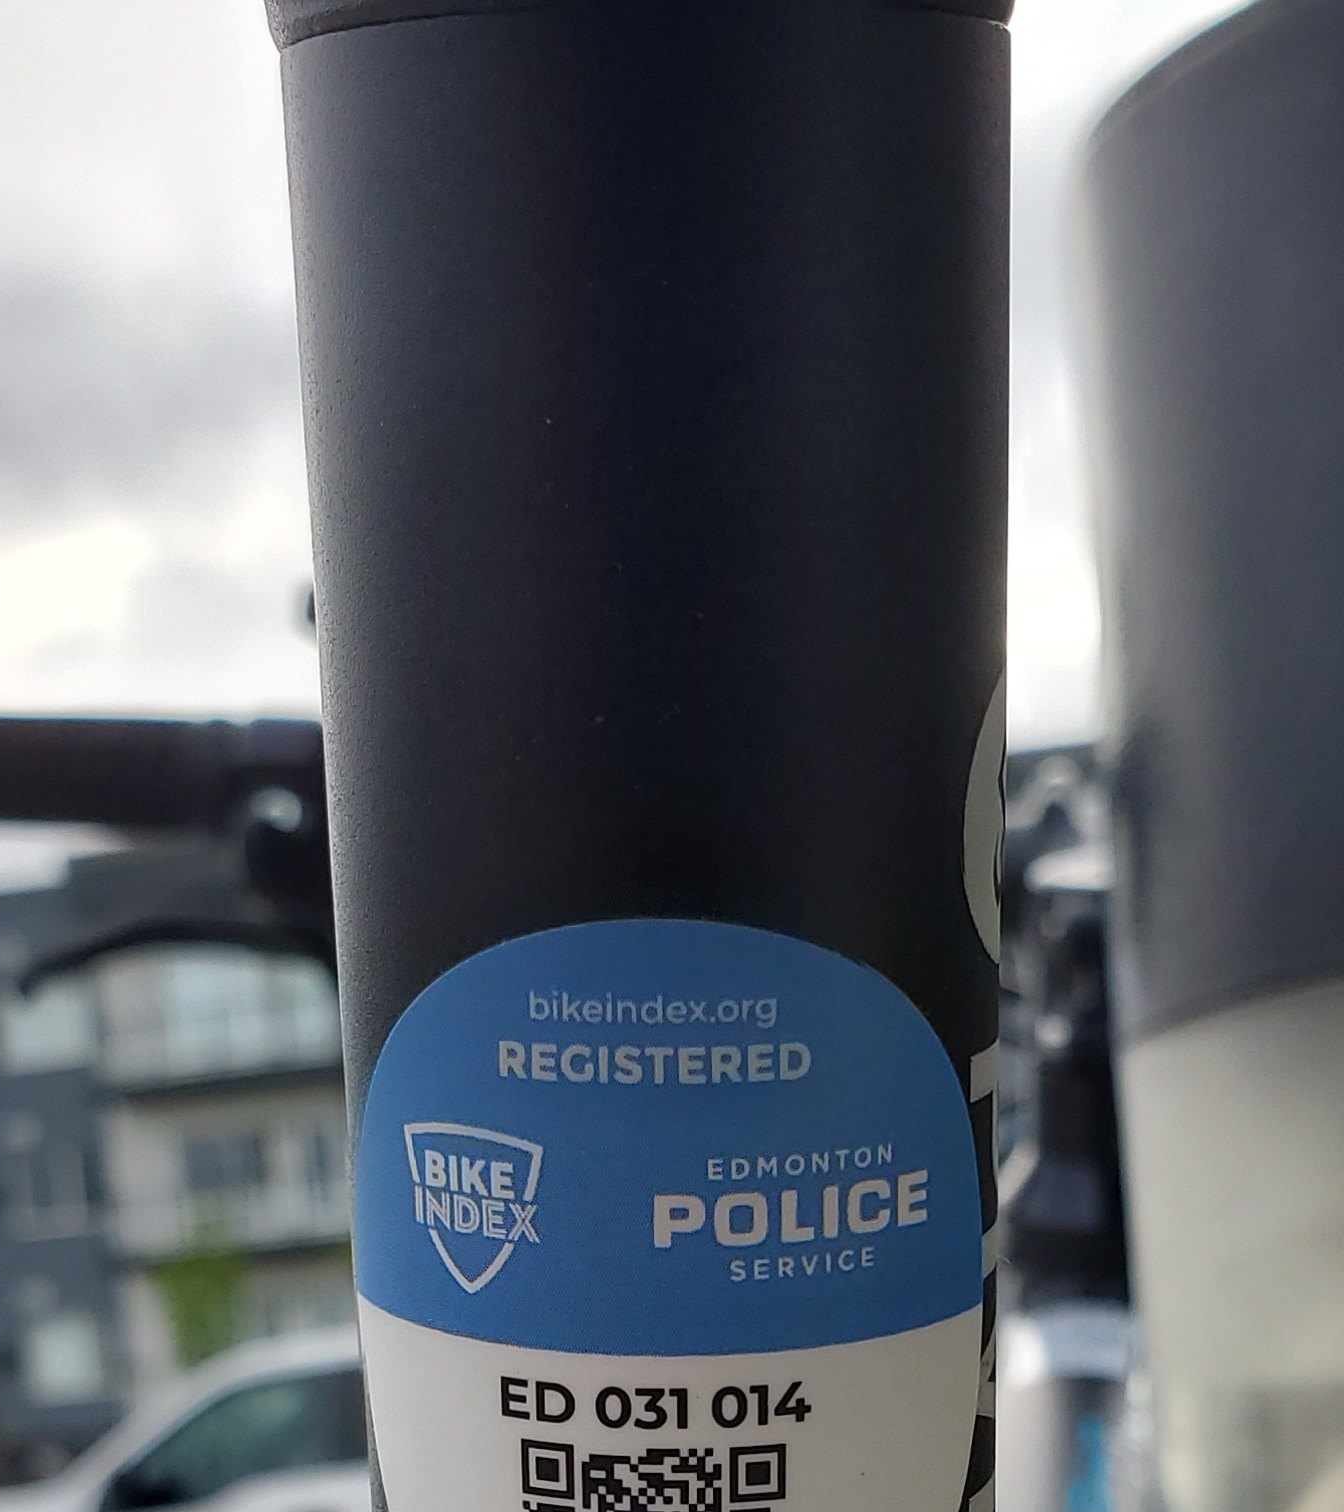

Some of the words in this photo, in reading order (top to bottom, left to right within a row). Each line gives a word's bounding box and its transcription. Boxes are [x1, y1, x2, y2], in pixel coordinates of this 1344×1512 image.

[528, 991, 778, 1028] bikeindex.org
[498, 1040, 812, 1085] REGISTERED
[423, 1149, 515, 1202] BIKE
[706, 1143, 894, 1182] EDMONTON
[413, 1185, 542, 1243] INDEX
[652, 1169, 929, 1249] POLICE
[729, 1246, 877, 1283] SERVICE
[499, 1375, 576, 1423] ED
[595, 1385, 690, 1430] 031
[711, 1380, 813, 1428] 014
